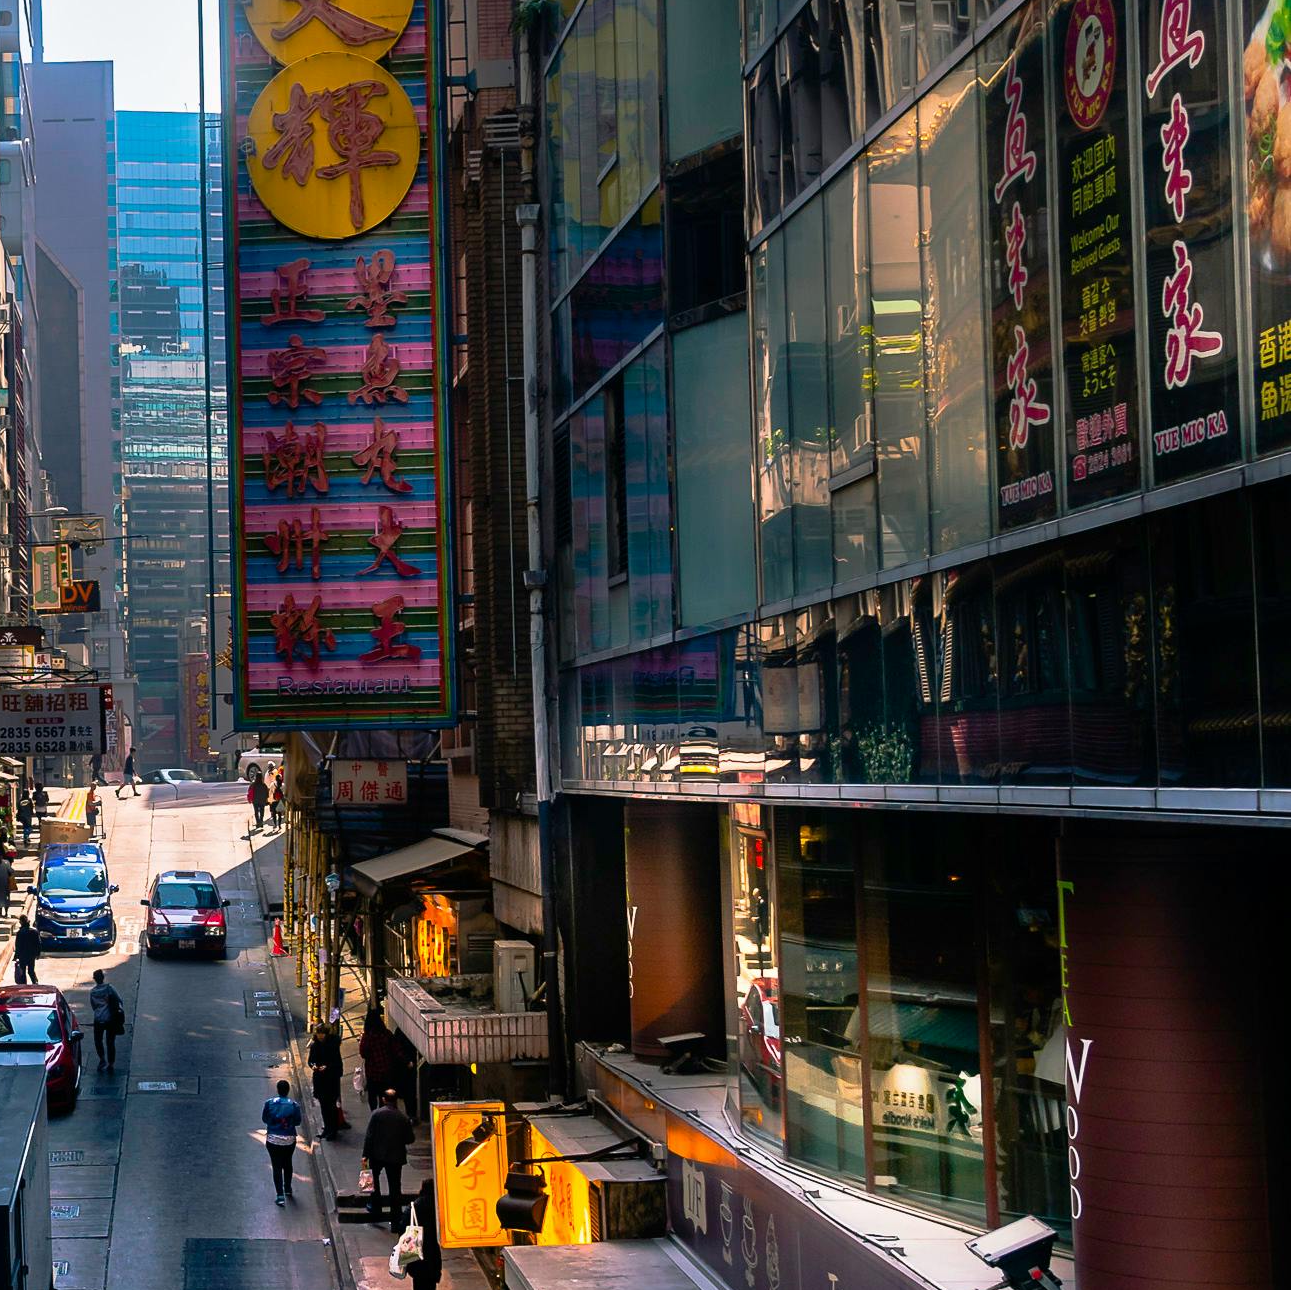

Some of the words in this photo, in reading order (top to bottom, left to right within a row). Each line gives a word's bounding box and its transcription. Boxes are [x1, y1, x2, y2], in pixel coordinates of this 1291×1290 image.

[1071, 223, 1105, 253] Welcome
[1106, 213, 1119, 233] Our
[1071, 249, 1098, 275] Beloved
[1098, 237, 1121, 260] Guests
[1154, 429, 1180, 456] YUE
[1181, 418, 1206, 447] MIC
[1207, 410, 1228, 439] KA
[1000, 485, 1019, 507] YUE
[1020, 480, 1037, 502] MIC
[1037, 471, 1053, 495] KA
[276, 675, 412, 696] Restaurant
[2, 692, 89, 712] 旺舖招租
[0, 726, 31, 739] 2835
[35, 725, 66, 738] 6567
[0, 742, 31, 754] 2835
[35, 741, 67, 754] 6528
[351, 762, 389, 778] 中醫
[336, 780, 406, 802] 周傑通
